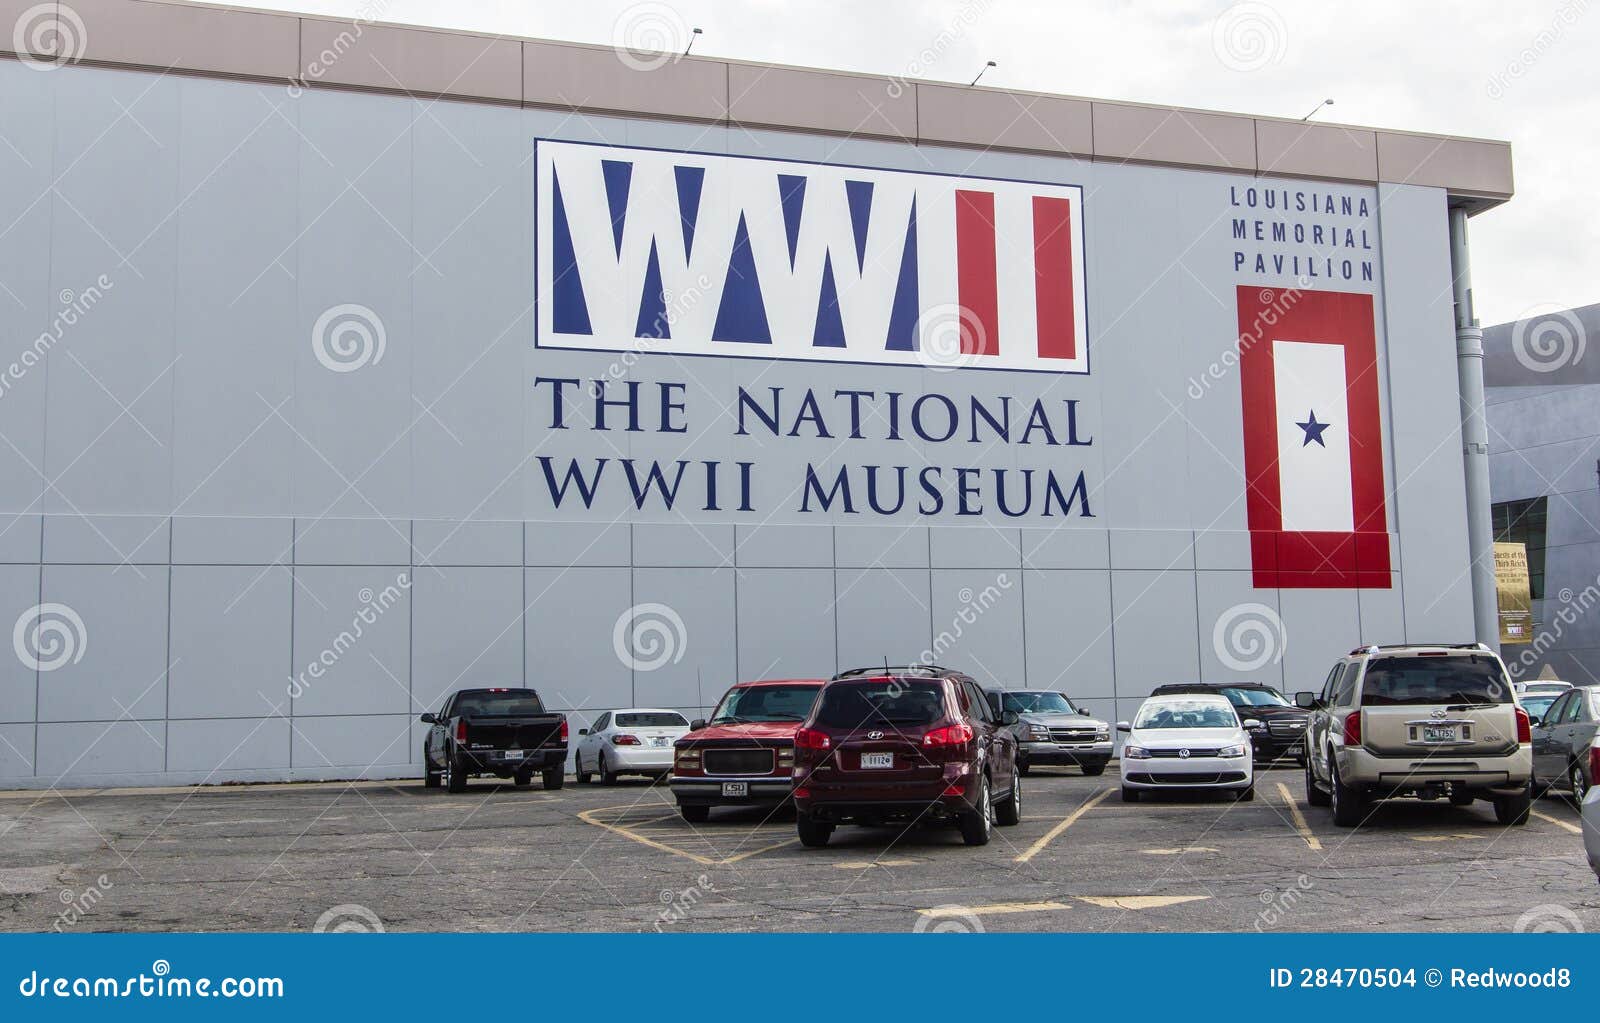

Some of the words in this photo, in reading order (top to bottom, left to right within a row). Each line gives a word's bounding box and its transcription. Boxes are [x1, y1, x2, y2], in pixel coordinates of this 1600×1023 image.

[1231, 186, 1369, 217] LOUISIANA
[540, 150, 1085, 366] WWII
[1232, 219, 1371, 250] MEMORIAL
[1234, 251, 1373, 281] PAVILION
[534, 376, 688, 434] THE
[733, 385, 1093, 447] NATIONAL
[535, 455, 756, 512] WWII
[797, 462, 1096, 518] MUSEUM
